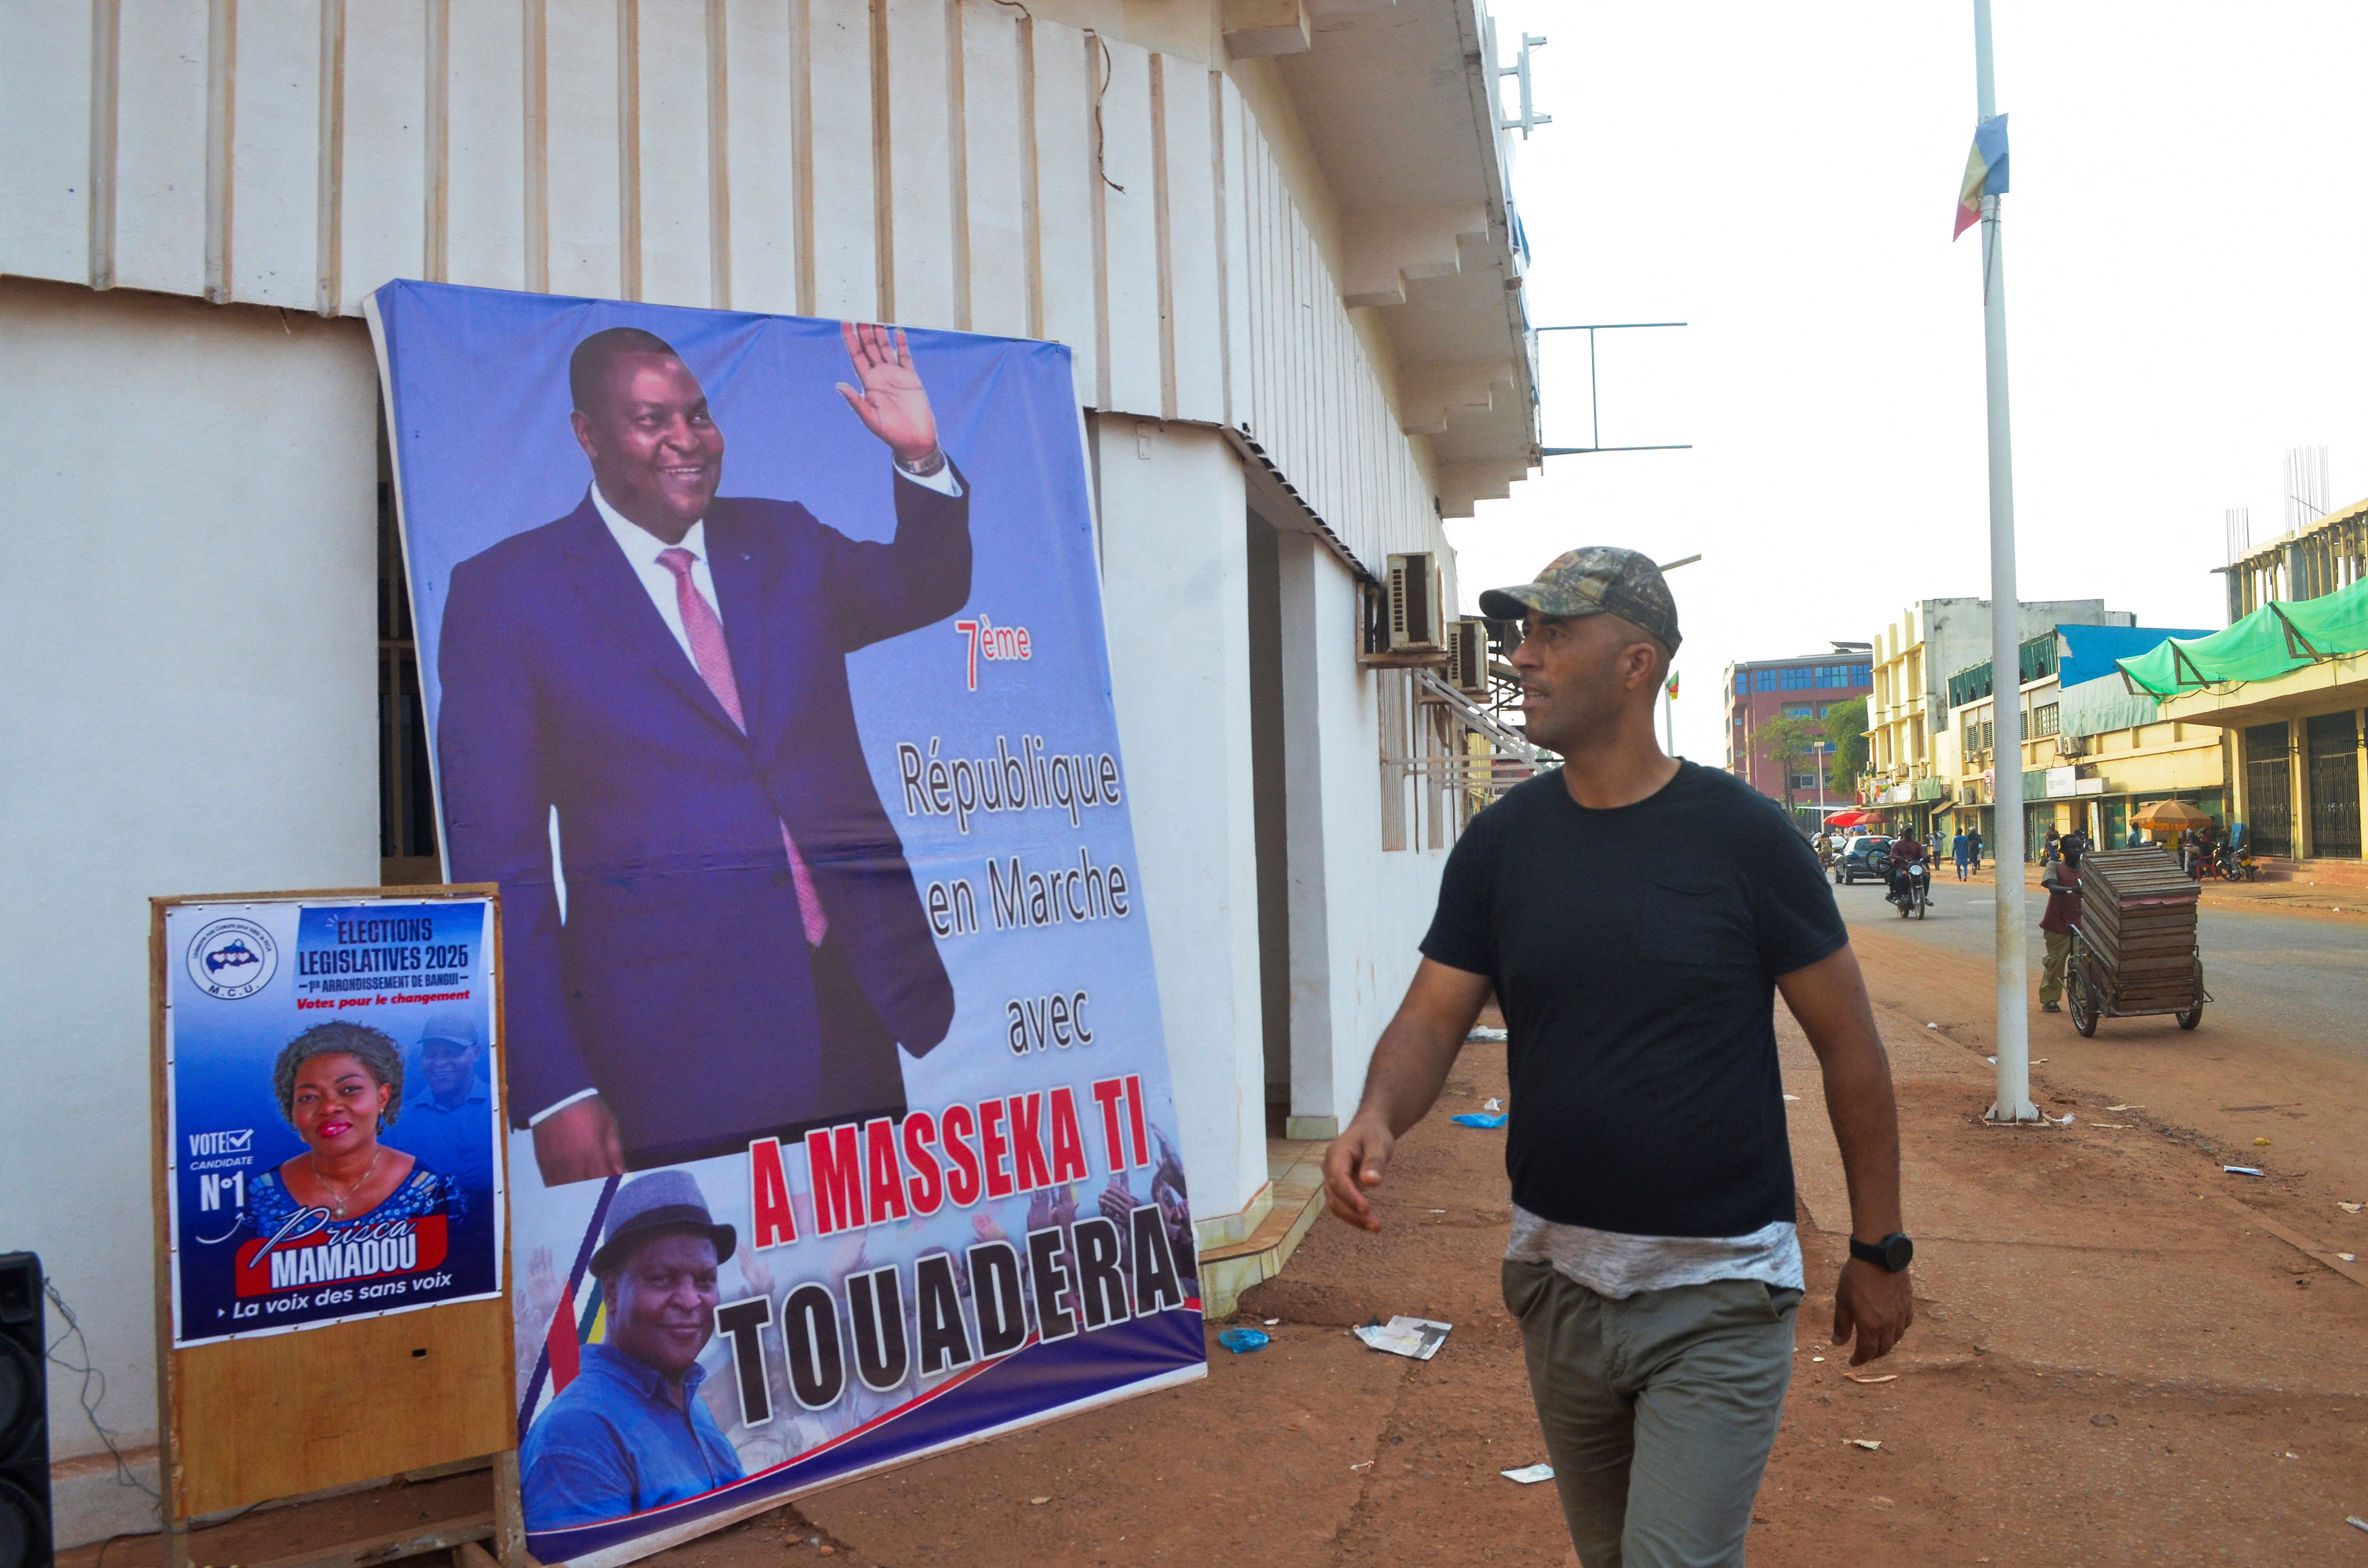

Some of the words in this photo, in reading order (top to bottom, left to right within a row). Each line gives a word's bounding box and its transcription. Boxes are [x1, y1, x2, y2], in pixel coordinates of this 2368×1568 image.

[954, 613, 1031, 691] 7ème
[897, 735, 1120, 835] République
[926, 879, 979, 938] en
[986, 845, 1130, 931] Marche
[338, 918, 432, 944] ELECTIONS
[300, 947, 421, 975] LEGISLATIVES
[425, 945, 469, 969] 2025
[322, 975, 410, 993] ARRONDISSEMENT
[412, 974, 423, 987] DE
[425, 973, 458, 986] BANGUI
[296, 998, 335, 1010] Votez
[338, 996, 372, 1010] pour
[375, 994, 388, 1005] le
[391, 990, 470, 1005] changement
[1006, 990, 1094, 1056] avec
[189, 1132, 226, 1156] VOTE
[190, 1156, 253, 1170] CANDIDATE
[749, 1137, 797, 1252] A
[804, 1085, 1089, 1238] MASSEKA
[1091, 1073, 1151, 1174] TI
[249, 1205, 418, 1269] Prisca
[270, 1233, 417, 1289] MAMADOU
[233, 1302, 259, 1319] La
[265, 1293, 308, 1314] voix
[315, 1289, 354, 1307] des
[359, 1280, 406, 1299] sans
[412, 1271, 452, 1291] voix
[714, 1203, 1185, 1428] TOUADERA
